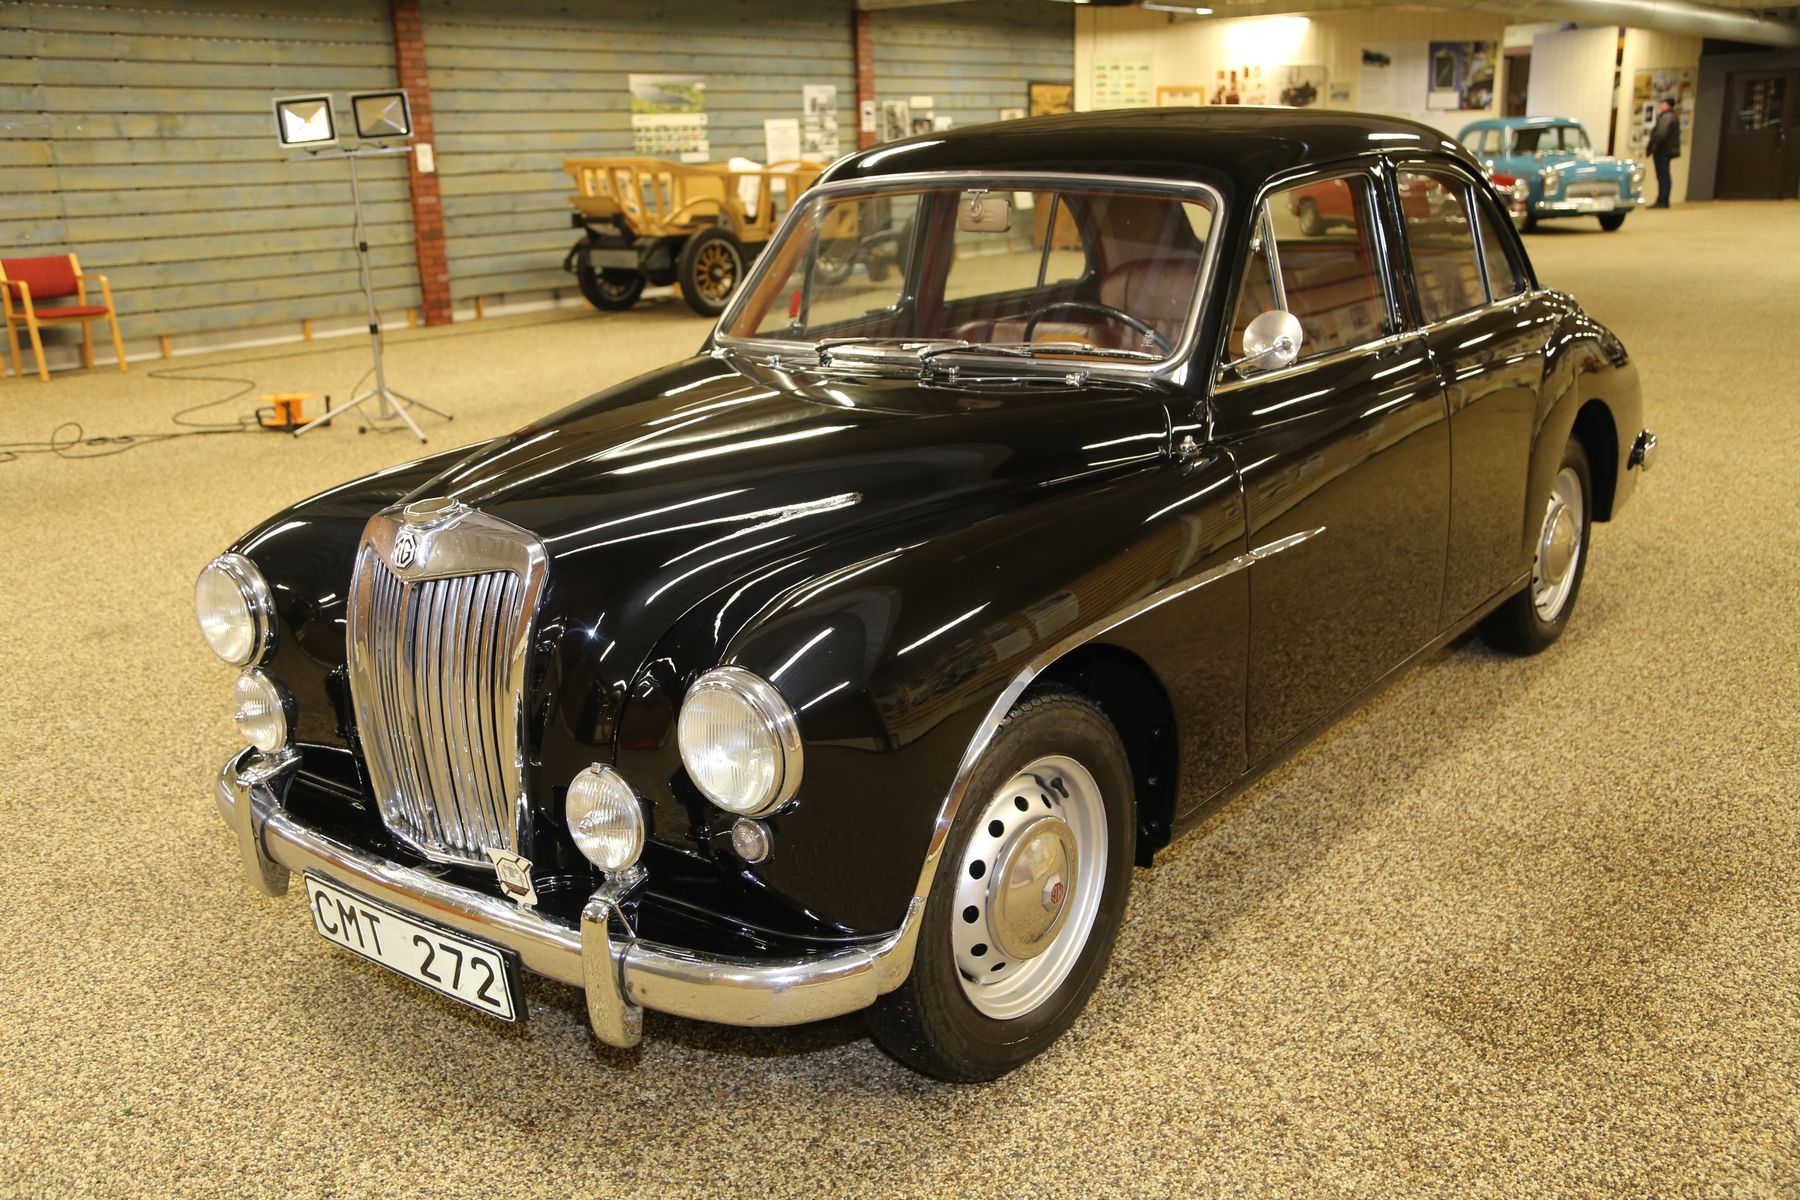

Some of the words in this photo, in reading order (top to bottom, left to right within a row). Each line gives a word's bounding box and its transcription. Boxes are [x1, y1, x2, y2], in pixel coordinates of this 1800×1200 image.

[395, 537, 413, 564] MG
[315, 890, 382, 955] CMT
[413, 934, 501, 1007] 272
